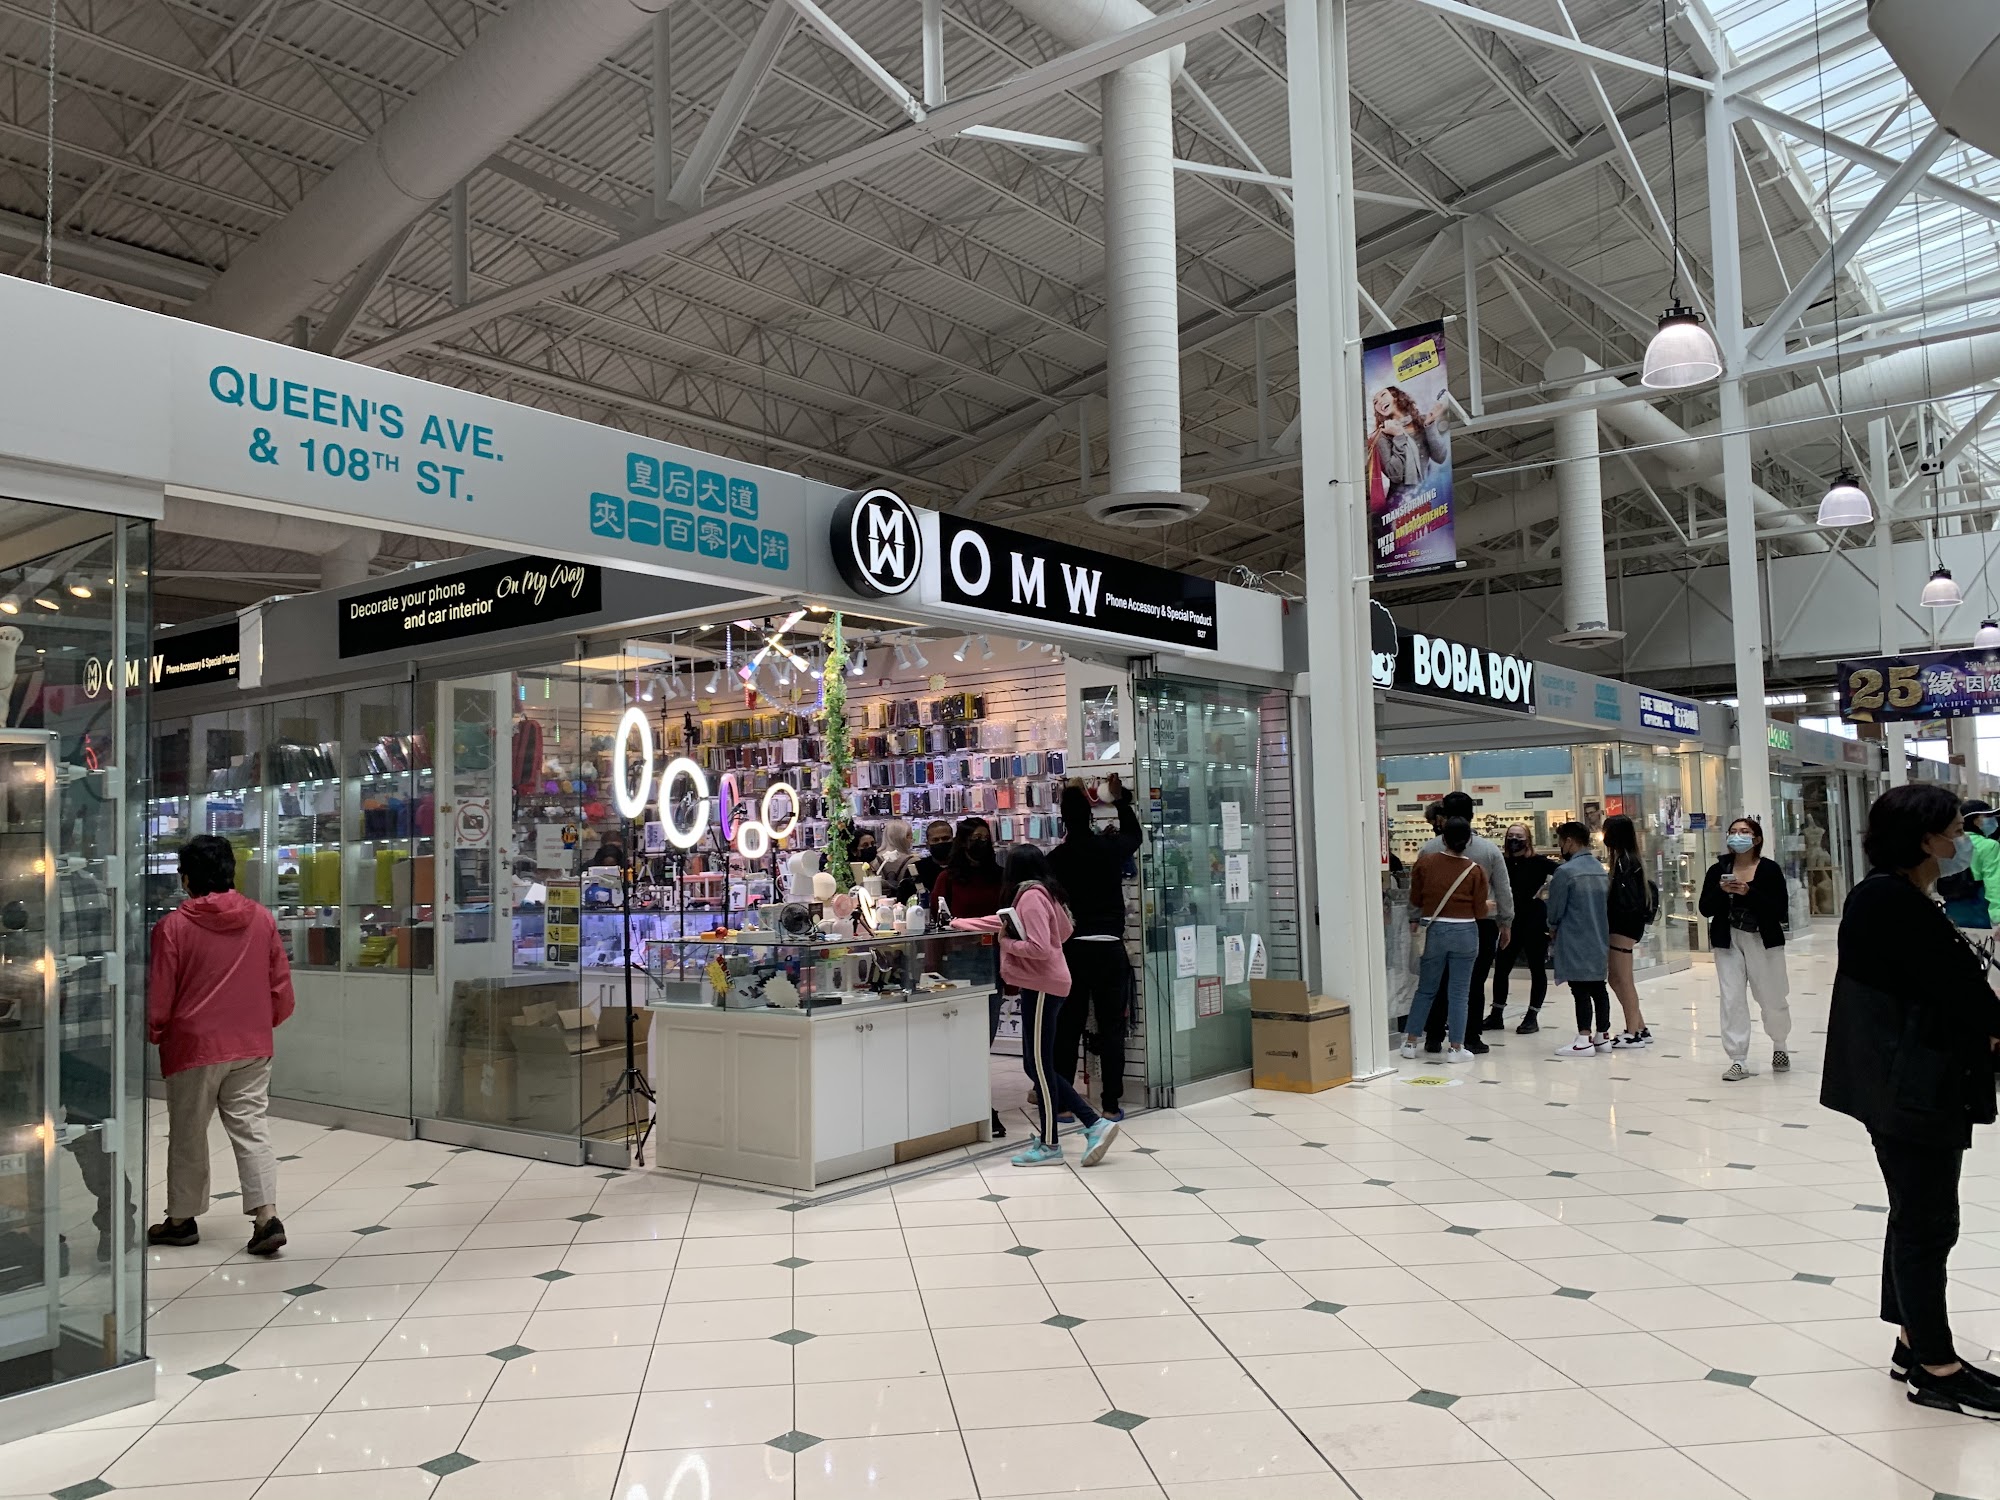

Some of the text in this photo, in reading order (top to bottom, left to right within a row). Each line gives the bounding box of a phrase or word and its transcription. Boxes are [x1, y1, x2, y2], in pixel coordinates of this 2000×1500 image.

[209, 366, 504, 462] QUEEN'S AVE.
[248, 427, 279, 466] &
[416, 461, 473, 502] ST.
[629, 460, 757, 517] 皇后大道
[1381, 488, 1437, 526] TRANSFORMING
[592, 500, 788, 565] 夾一百零八街
[1377, 531, 1395, 549] INTO
[1380, 541, 1395, 558] FOR
[1407, 549, 1421, 558] 365
[350, 582, 466, 620] Decorate your phone
[497, 564, 585, 606] On My Way
[404, 598, 494, 630] and car interior
[1105, 592, 1213, 627] Phone Accessory & Special Product
[166, 664, 180, 675] Phone
[179, 660, 202, 672] Accessory
[205, 655, 223, 668] Special
[222, 651, 240, 665] Product
[1413, 633, 1533, 705] BOBA BOY
[1964, 661, 1981, 669] 25th
[1848, 664, 1923, 710] 25
[1932, 699, 1971, 710] PACIFIC
[1153, 718, 1174, 731] NOW
[1153, 730, 1175, 740] HIRING
